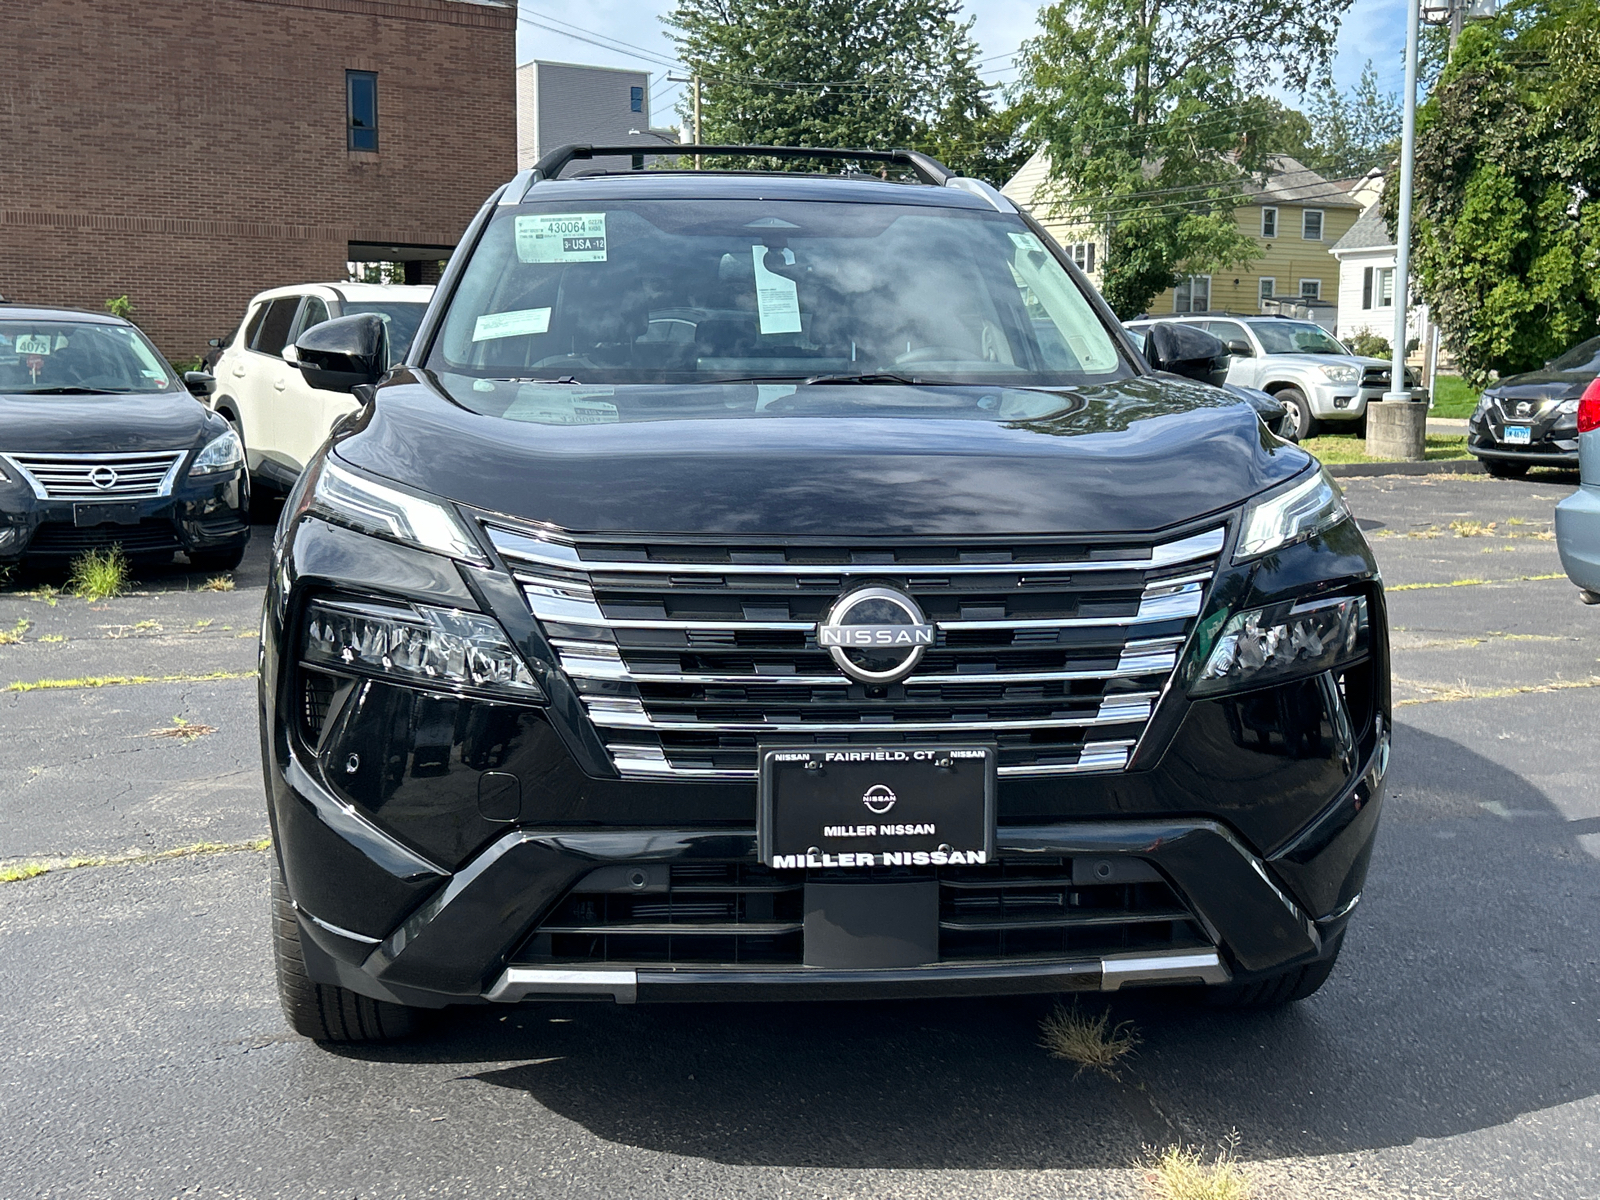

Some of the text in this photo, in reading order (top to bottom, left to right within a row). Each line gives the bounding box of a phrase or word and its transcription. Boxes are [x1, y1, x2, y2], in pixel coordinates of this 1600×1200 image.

[547, 221, 586, 234] 430064
[572, 238, 592, 249] USA
[19, 341, 47, 353] 4075
[824, 629, 932, 644] NISSAN
[775, 753, 810, 762] NISSAN
[825, 751, 935, 762] FAIRFIELD, CT
[950, 750, 986, 758] NISSAN
[824, 824, 935, 836] MILLER NISSAN
[772, 850, 987, 869] MILLER NISSAN
